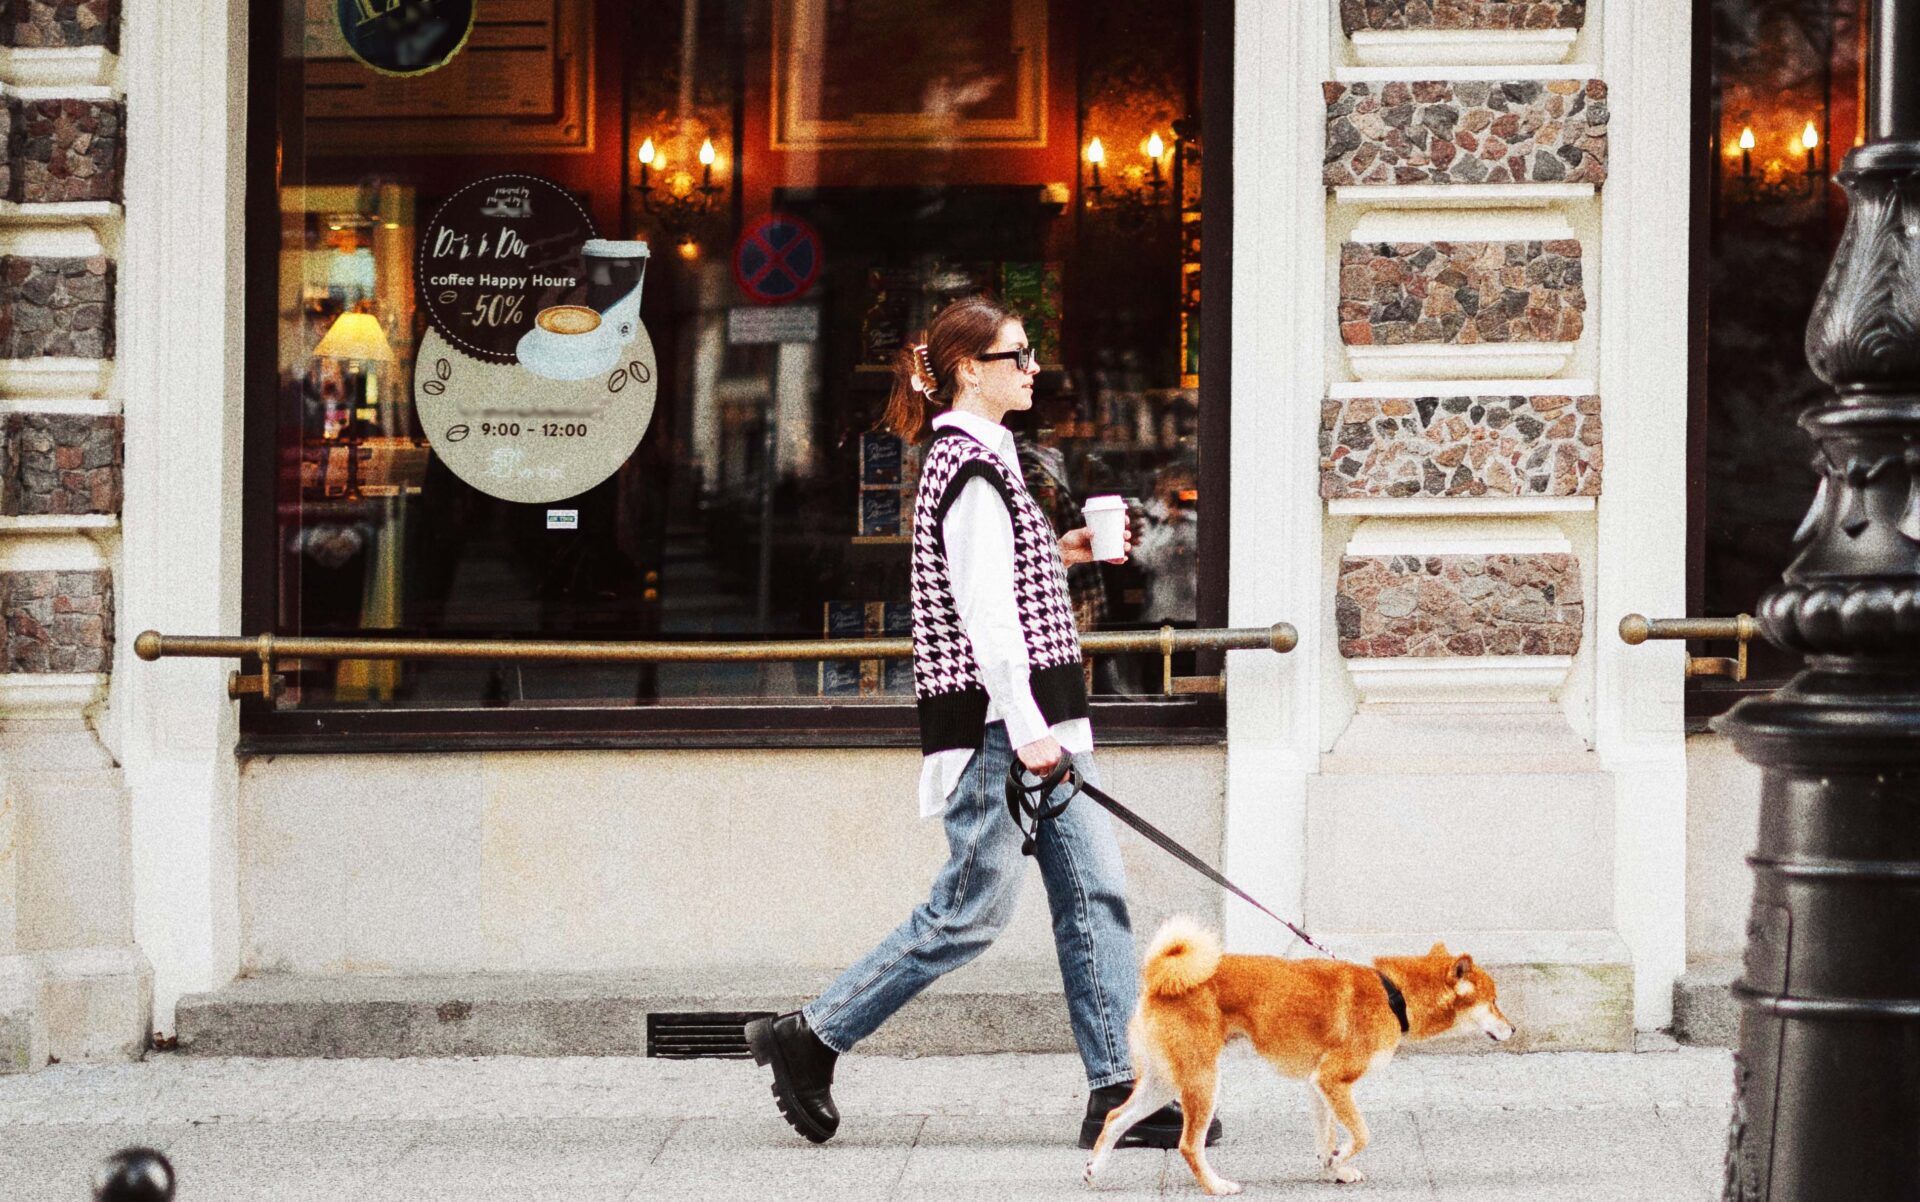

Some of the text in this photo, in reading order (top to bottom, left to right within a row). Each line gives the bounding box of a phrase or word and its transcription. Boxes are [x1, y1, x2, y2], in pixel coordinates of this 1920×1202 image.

[430, 273, 576, 289] coffee Happy Hours
[461, 294, 525, 327] -50%
[481, 422, 521, 437] 9:00
[542, 423, 588, 437] 12:00
